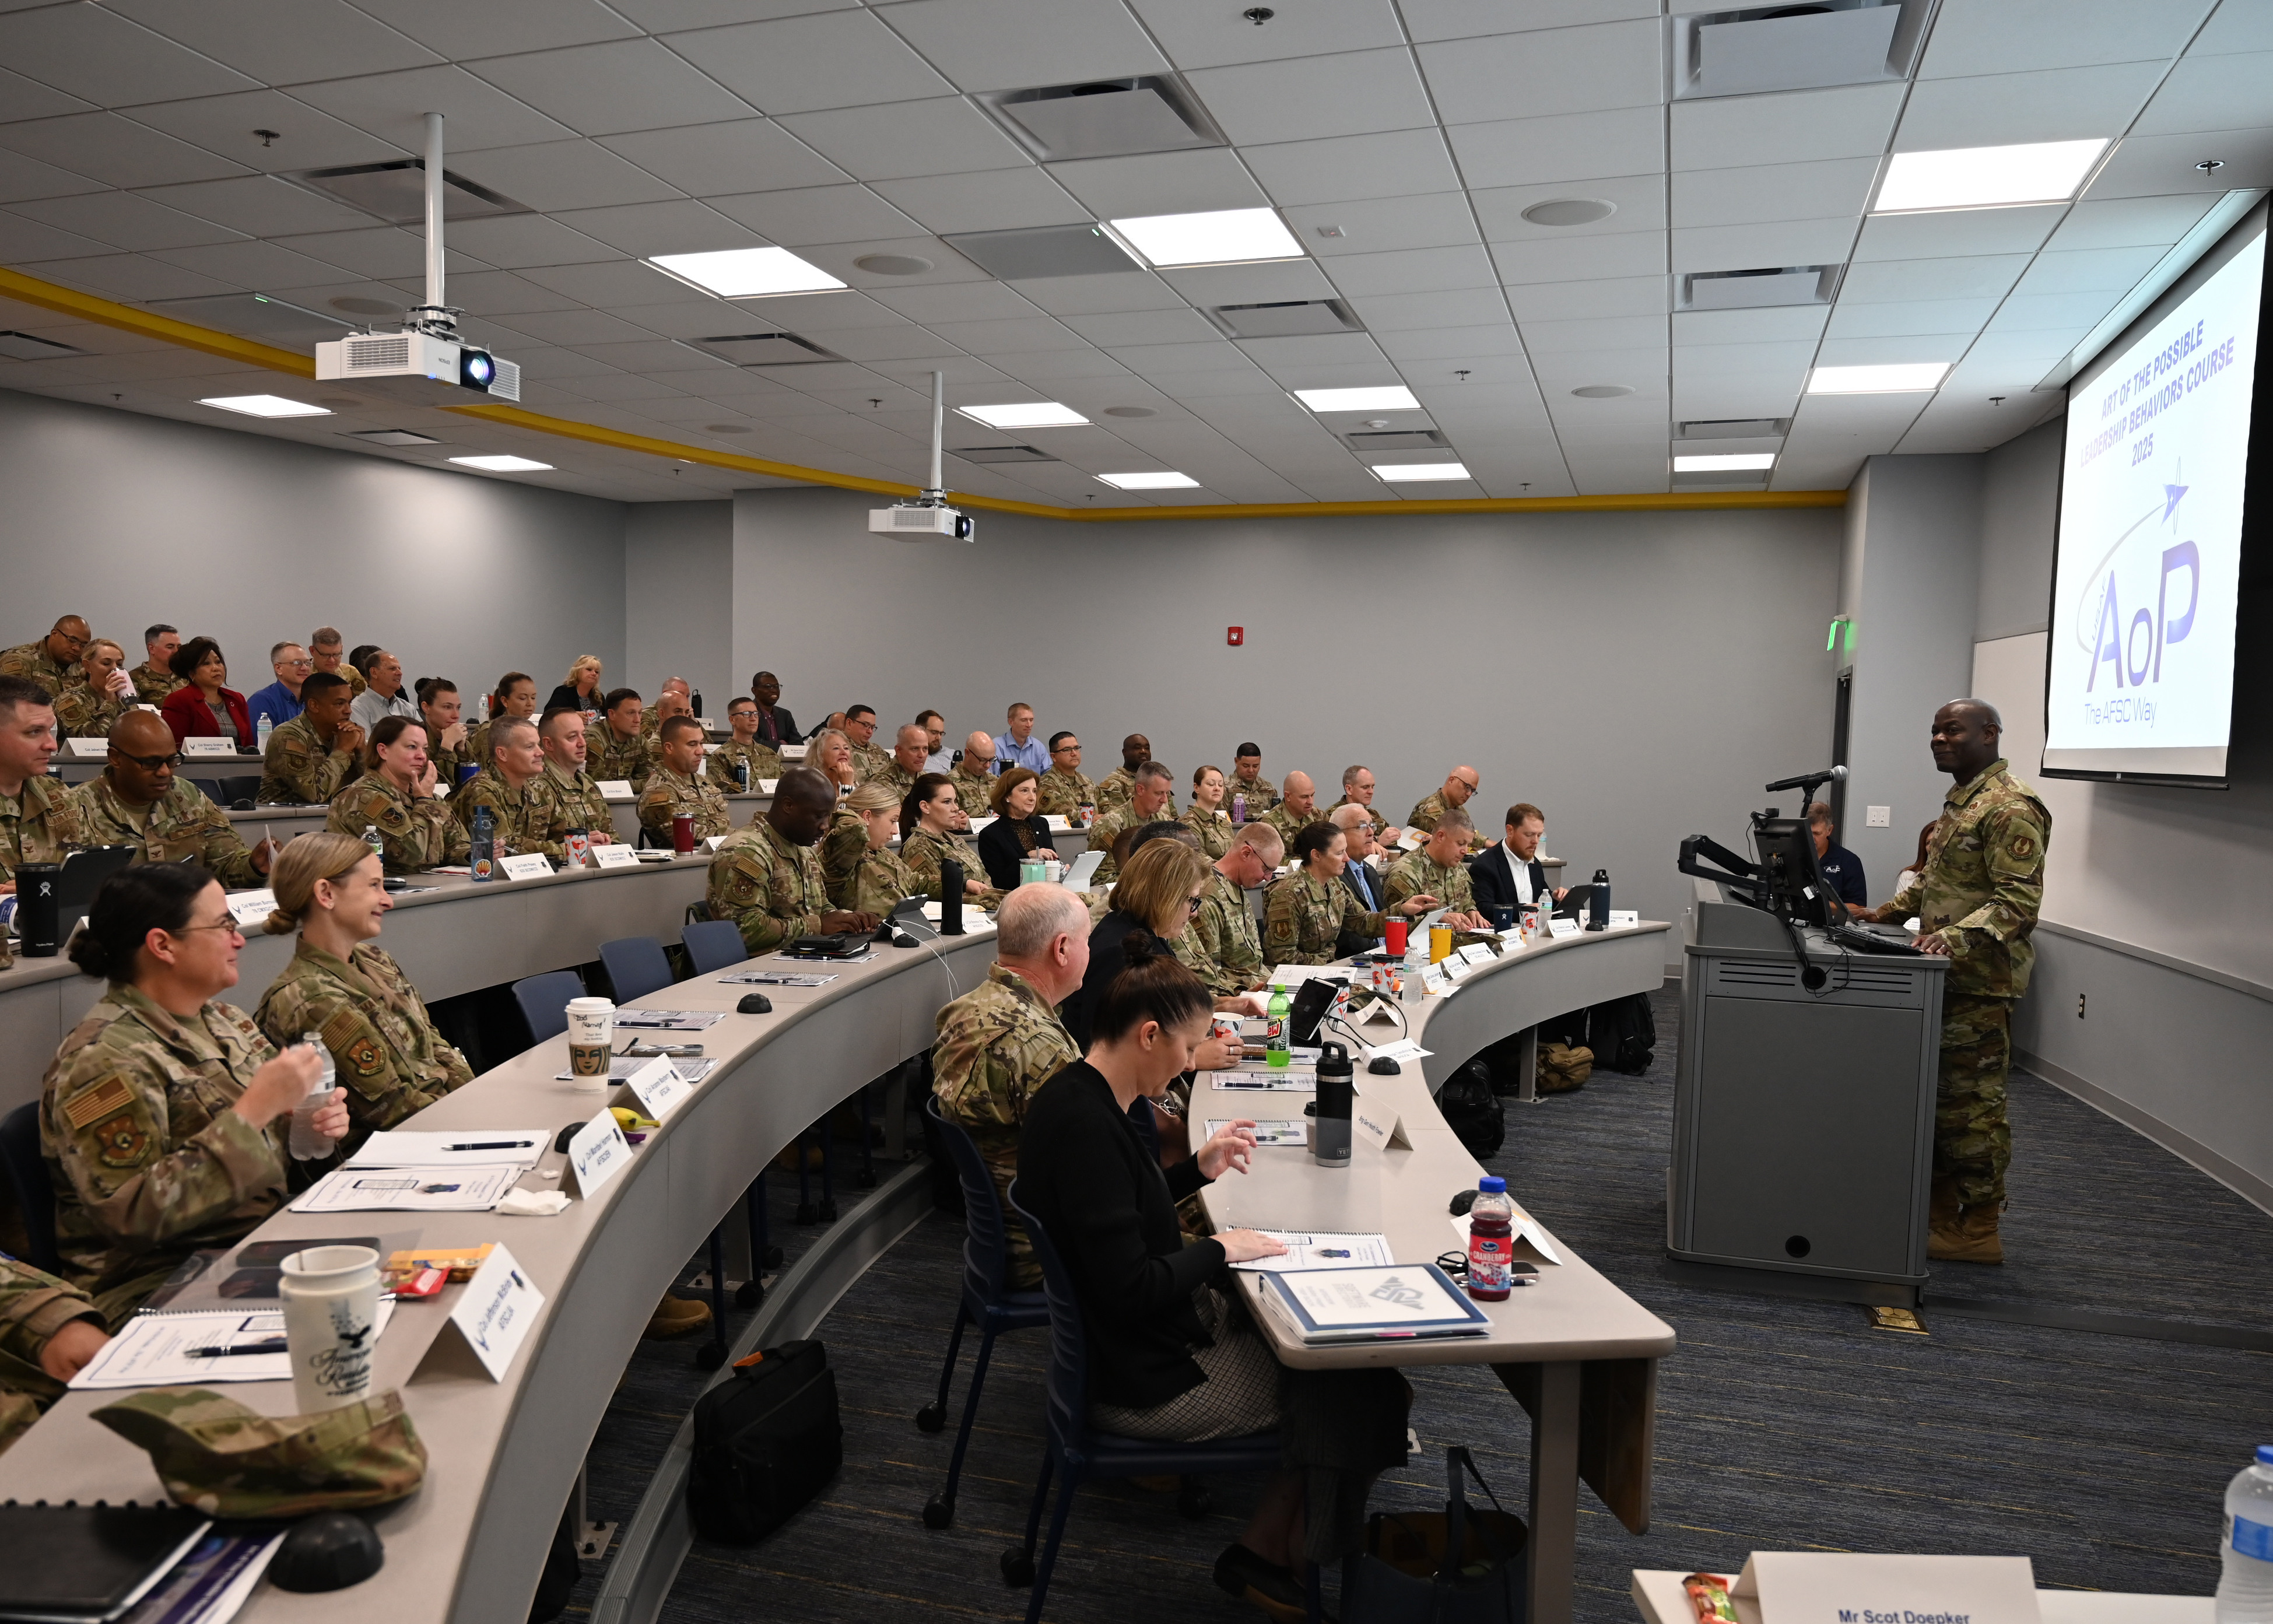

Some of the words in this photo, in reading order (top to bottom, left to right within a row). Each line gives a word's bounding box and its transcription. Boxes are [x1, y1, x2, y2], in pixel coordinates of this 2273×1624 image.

[2102, 389, 2118, 421] ART
[2120, 378, 2131, 406] OF
[2134, 362, 2152, 396] THE
[2153, 318, 2204, 381] POSSIBLE
[2081, 416, 2127, 468] LEADERSHIP
[2129, 374, 2183, 434] BEHAVIORS
[2187, 336, 2235, 394] COURSE
[2132, 432, 2153, 467] 2025
[2086, 540, 2200, 693] AoP
[2085, 703, 2101, 725] The
[2102, 698, 2131, 724] AFSC
[2134, 696, 2157, 728] Way
[1473, 1250, 1505, 1261] CRANBERRY
[1838, 1609, 1859, 1623] Mr
[1863, 1609, 1900, 1624] Scot
[1904, 1610, 1970, 1624] Doepker
